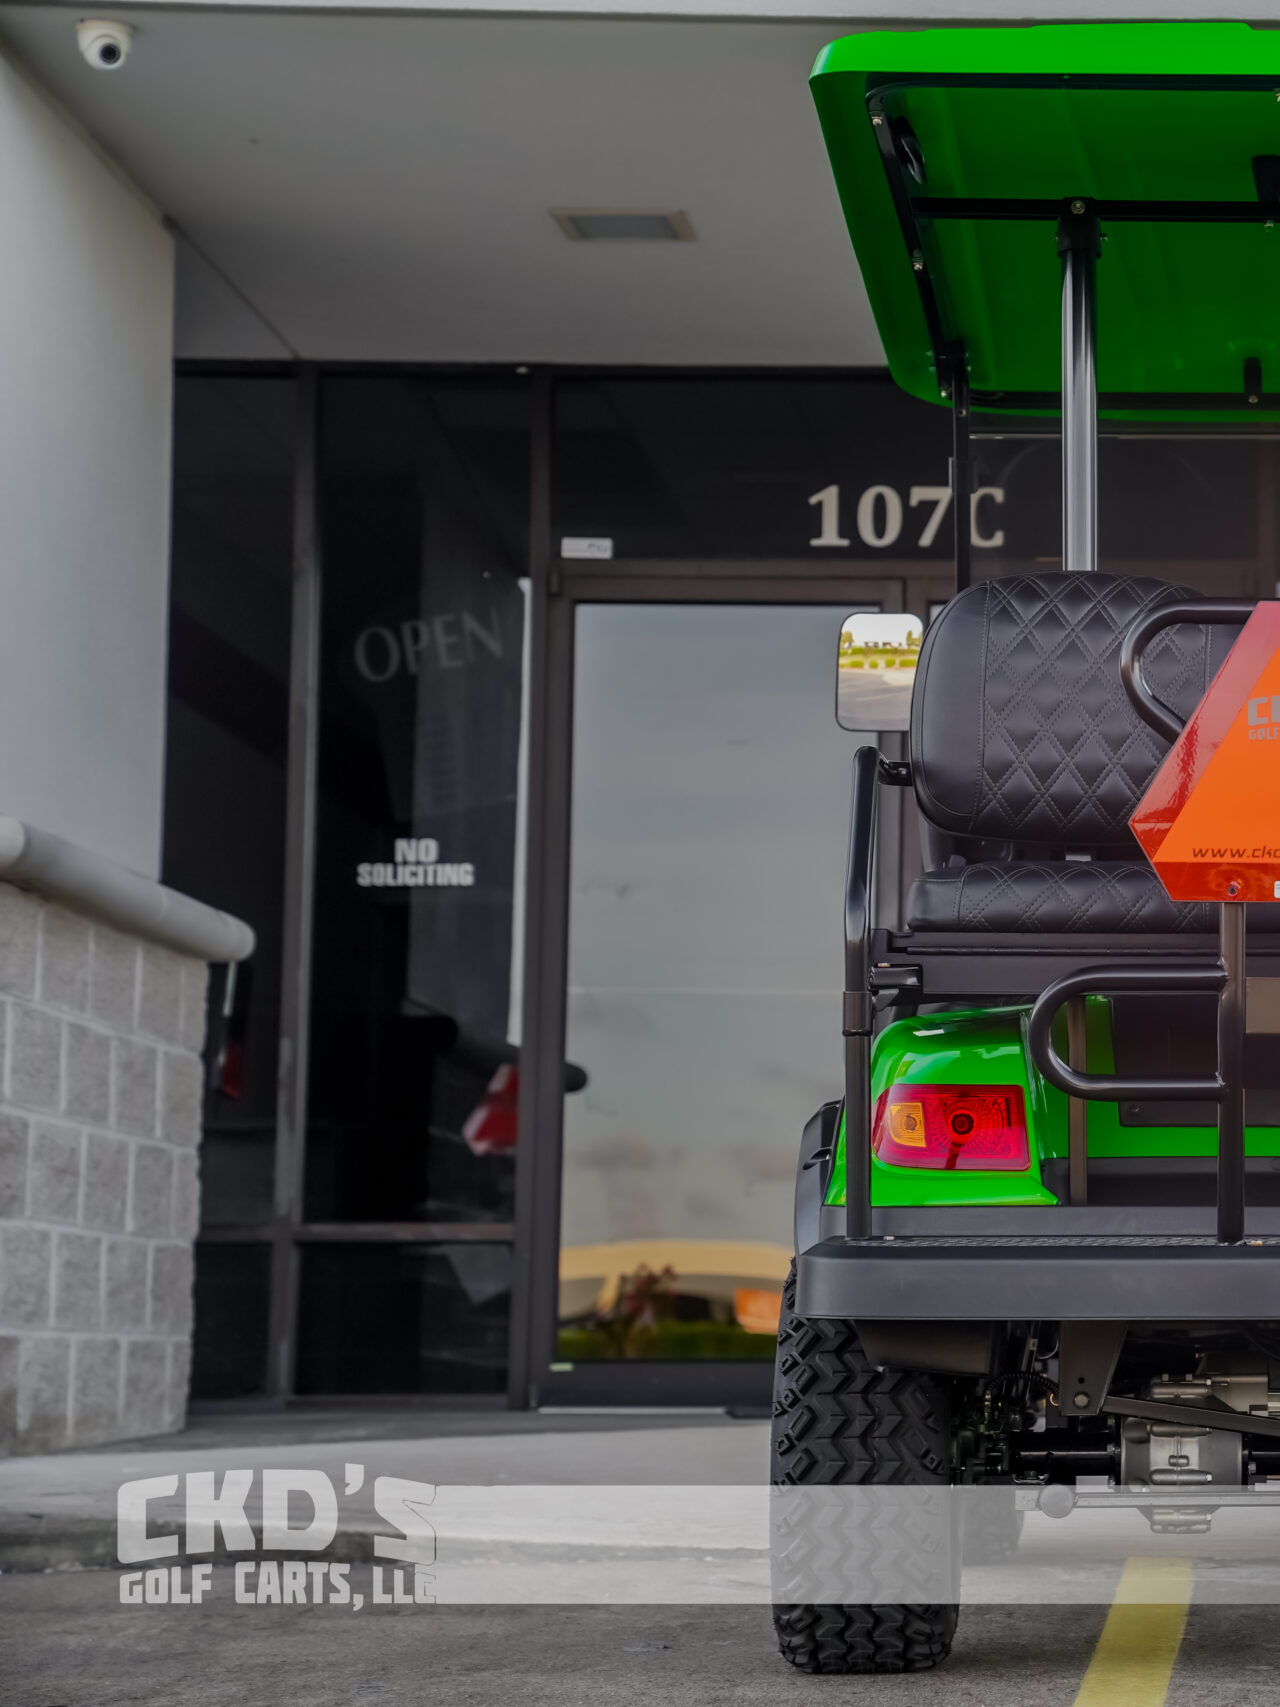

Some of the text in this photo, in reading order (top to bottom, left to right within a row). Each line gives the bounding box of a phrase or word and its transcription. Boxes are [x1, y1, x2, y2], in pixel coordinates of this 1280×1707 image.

[807, 484, 1005, 548] 107C
[354, 608, 504, 683] OPEN
[1248, 727, 1280, 740] GOLF
[394, 837, 439, 863] NO
[356, 863, 475, 887] SOLICITING
